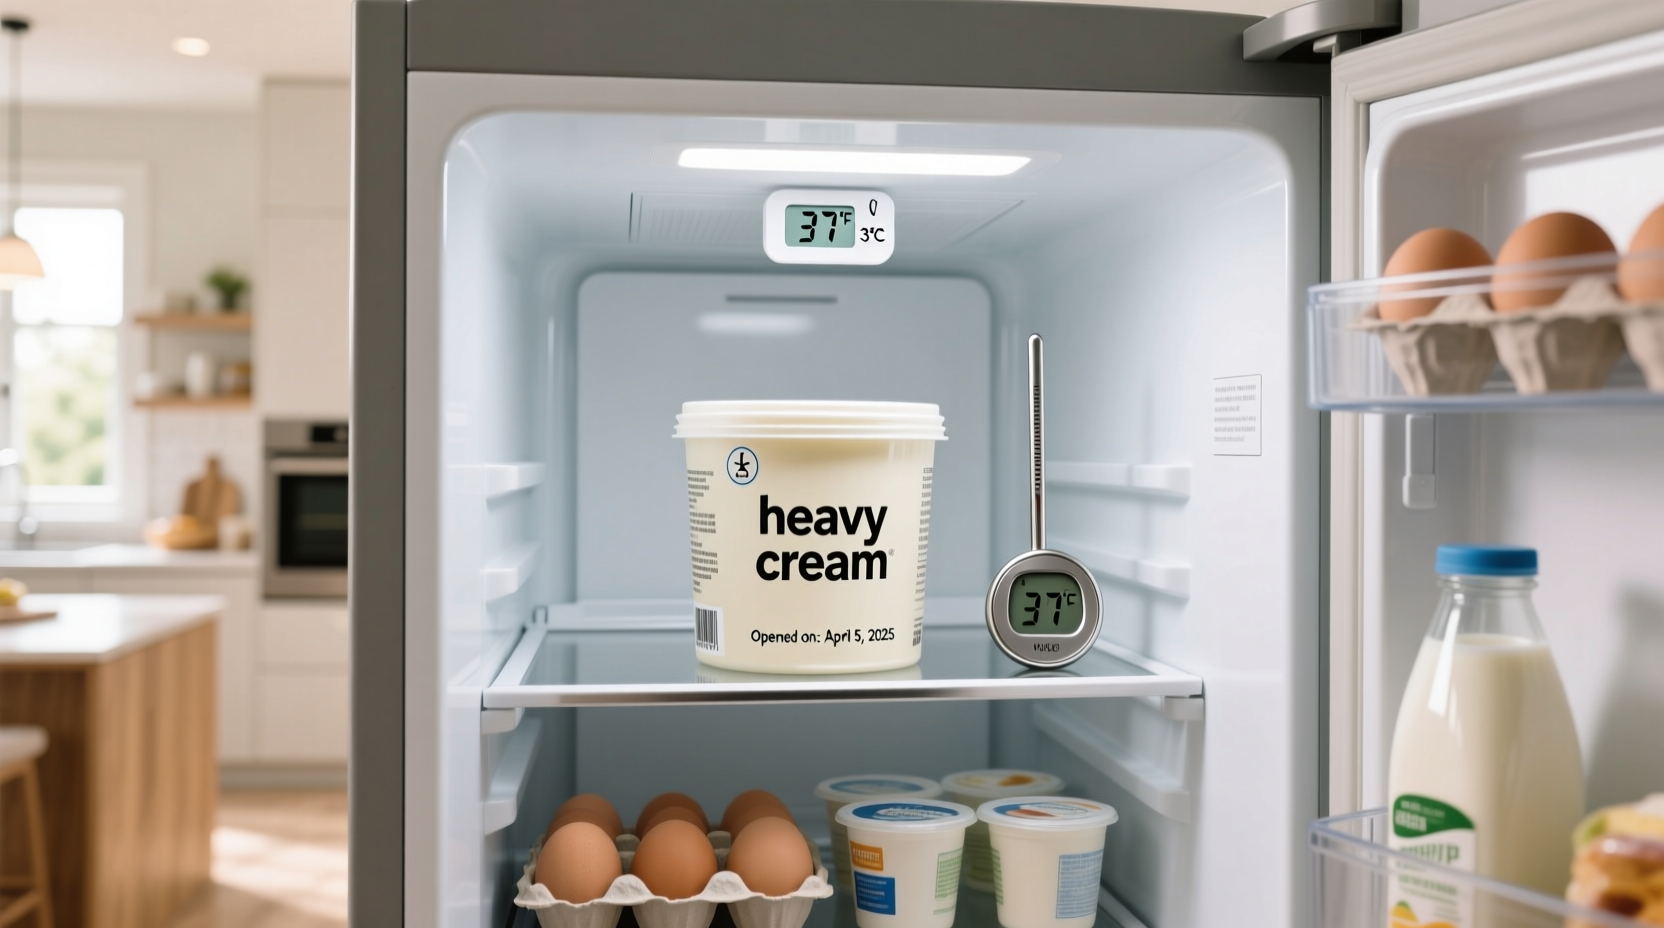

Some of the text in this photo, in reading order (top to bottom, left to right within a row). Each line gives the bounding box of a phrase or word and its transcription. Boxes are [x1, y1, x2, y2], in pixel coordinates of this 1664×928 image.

[759, 494, 888, 547] heavy
[755, 550, 888, 582] cream
[750, 629, 798, 647] Opened
[800, 632, 821, 645] on:
[854, 628, 865, 646] 5,
[867, 627, 895, 642] 2025
